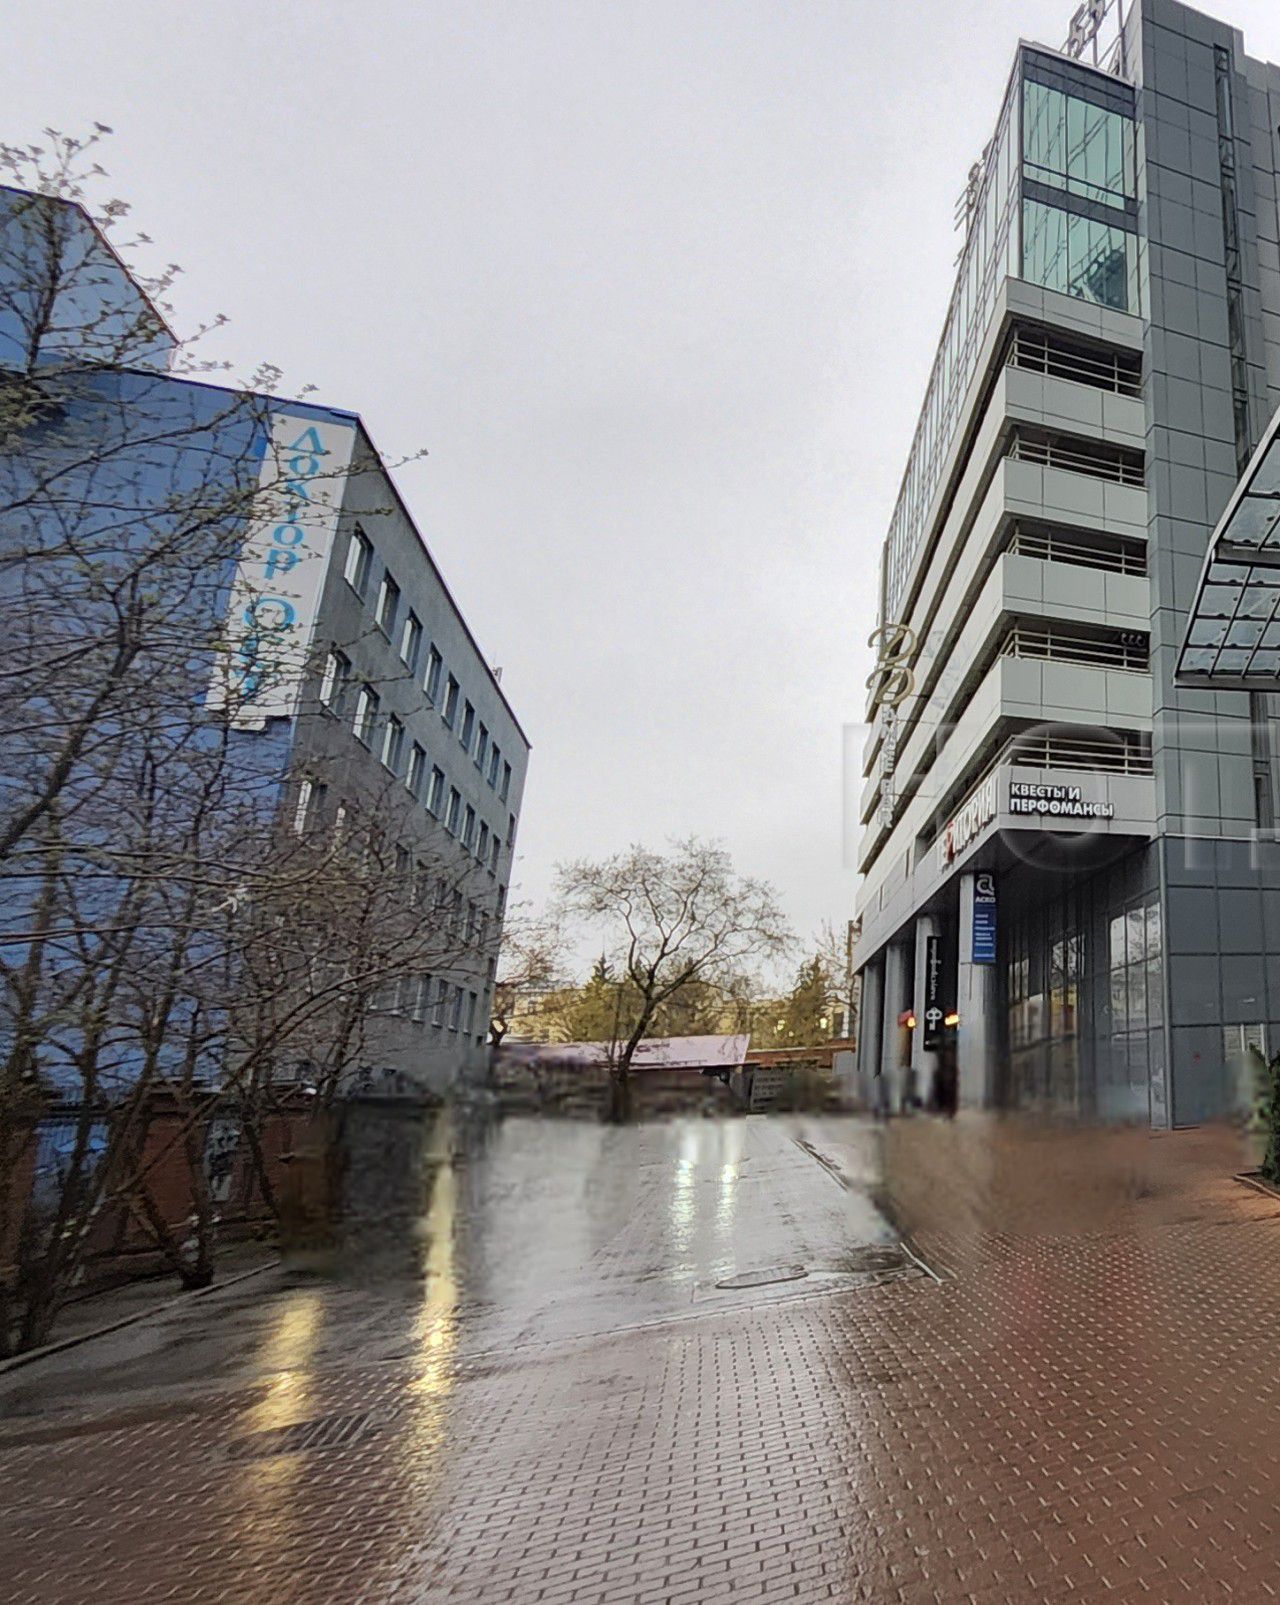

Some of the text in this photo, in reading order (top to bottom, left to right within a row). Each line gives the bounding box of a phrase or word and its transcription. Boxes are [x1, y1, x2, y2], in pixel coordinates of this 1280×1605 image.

[1011, 783, 1081, 800] КВЕСТЫ И
[1010, 798, 1114, 817] ПЕРФОМАНСЫ
